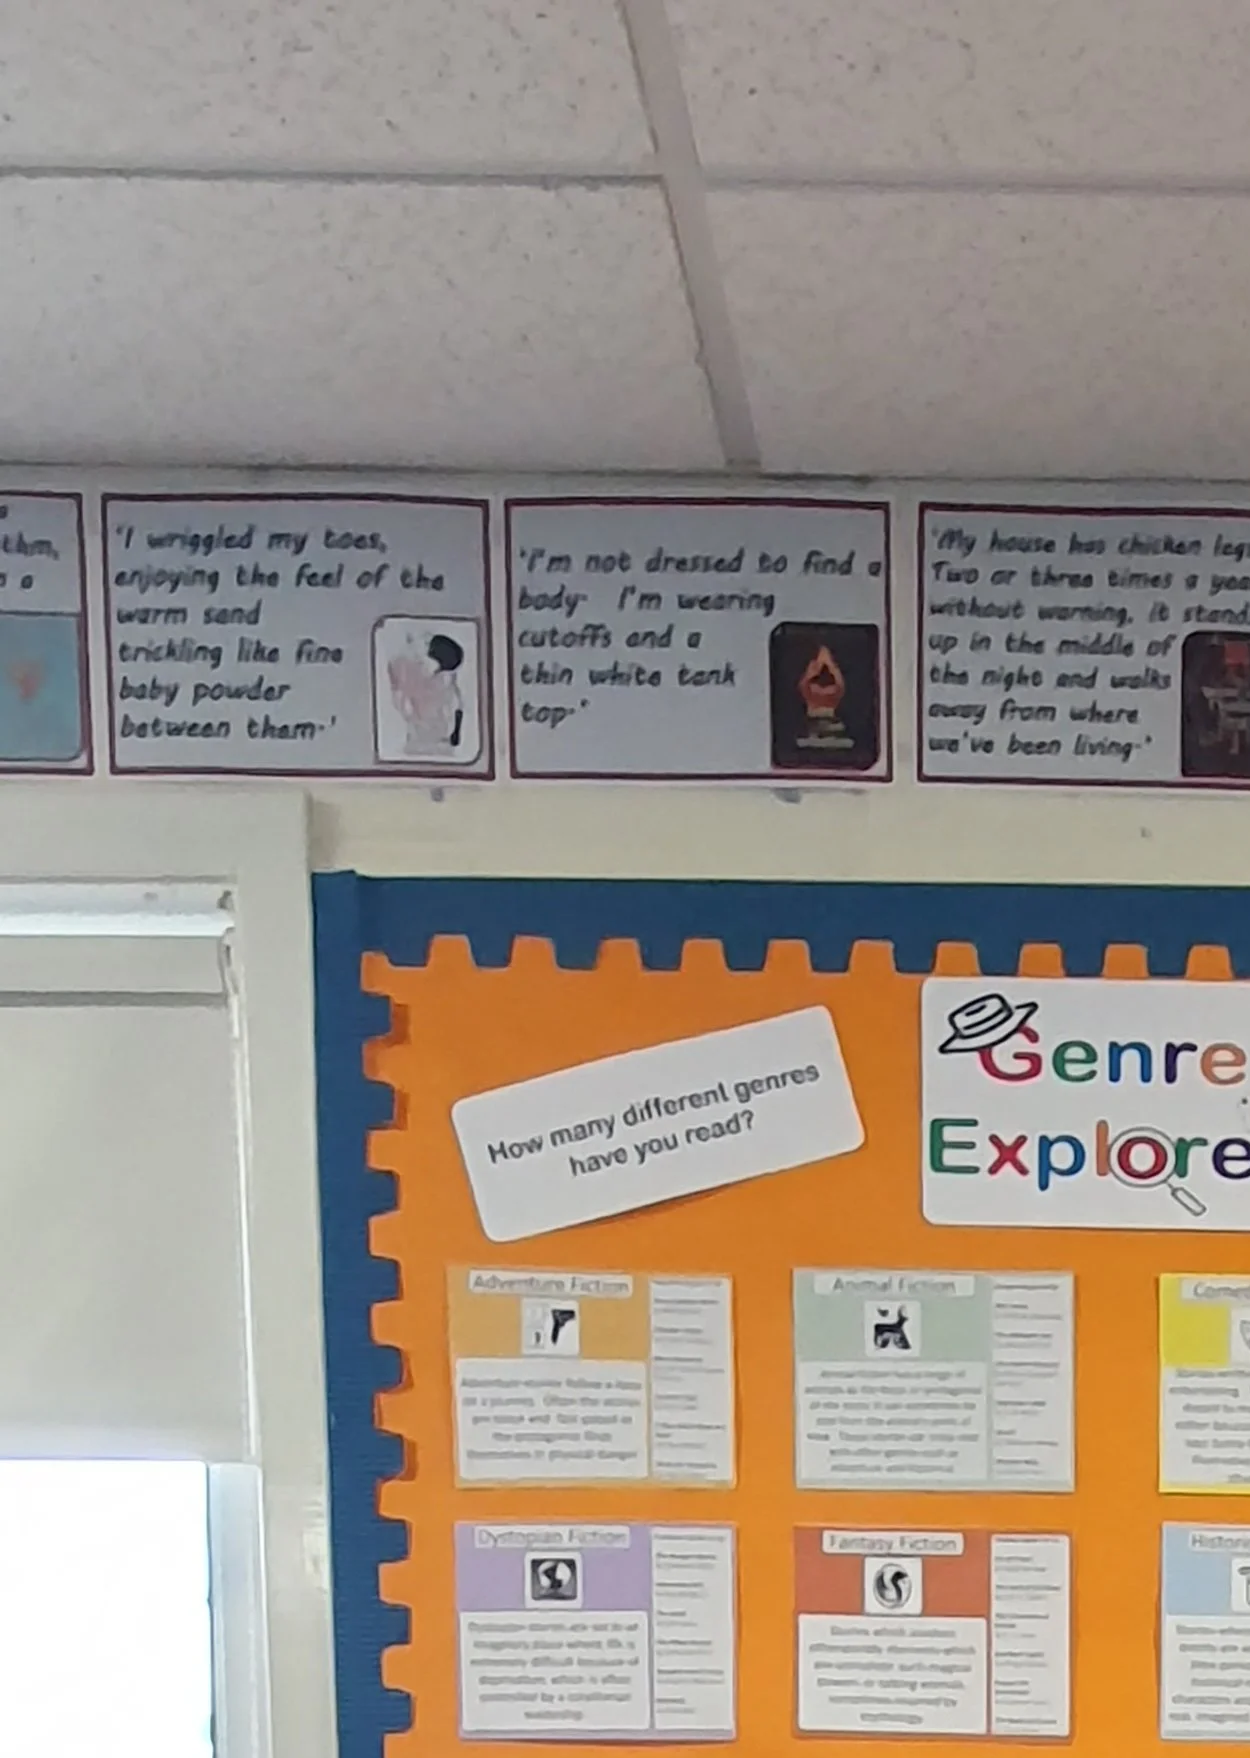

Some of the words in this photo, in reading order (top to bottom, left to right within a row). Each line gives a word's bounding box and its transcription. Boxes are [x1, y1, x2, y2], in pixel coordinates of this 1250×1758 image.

[147, 524, 255, 556] wriggled
[267, 533, 308, 556] my
[988, 529, 1056, 553] house
[1118, 534, 1202, 555] chicken
[114, 569, 219, 594] enjoying
[236, 562, 279, 587] the
[295, 563, 344, 588] feel
[356, 563, 390, 589] of
[400, 564, 444, 591] the
[585, 551, 631, 573] not
[645, 547, 745, 573] dressed
[757, 552, 787, 573] to
[803, 550, 855, 576] find
[868, 560, 882, 577] a
[117, 607, 187, 624] warm
[204, 599, 262, 625] sand
[618, 585, 662, 610] I'm
[677, 594, 775, 617] wearing
[518, 624, 611, 648] cutoffs
[626, 624, 674, 648] and
[687, 632, 702, 648] a
[119, 638, 223, 670] trickling
[237, 636, 279, 663] like
[296, 639, 343, 664] fine
[520, 663, 573, 686] thin
[589, 661, 661, 687] white
[678, 662, 735, 686] tank
[119, 675, 180, 707] baby
[192, 675, 291, 706] powder
[120, 714, 230, 739] between
[928, 731, 994, 754] we've
[1007, 733, 1061, 755] been
[977, 1024, 1247, 1085] Genre
[487, 1134, 543, 1165] How
[550, 1114, 616, 1148] many
[621, 1081, 729, 1127] different
[733, 1063, 820, 1103] genres
[568, 1145, 628, 1177] have
[634, 1132, 679, 1166] you
[684, 1110, 756, 1146] read?
